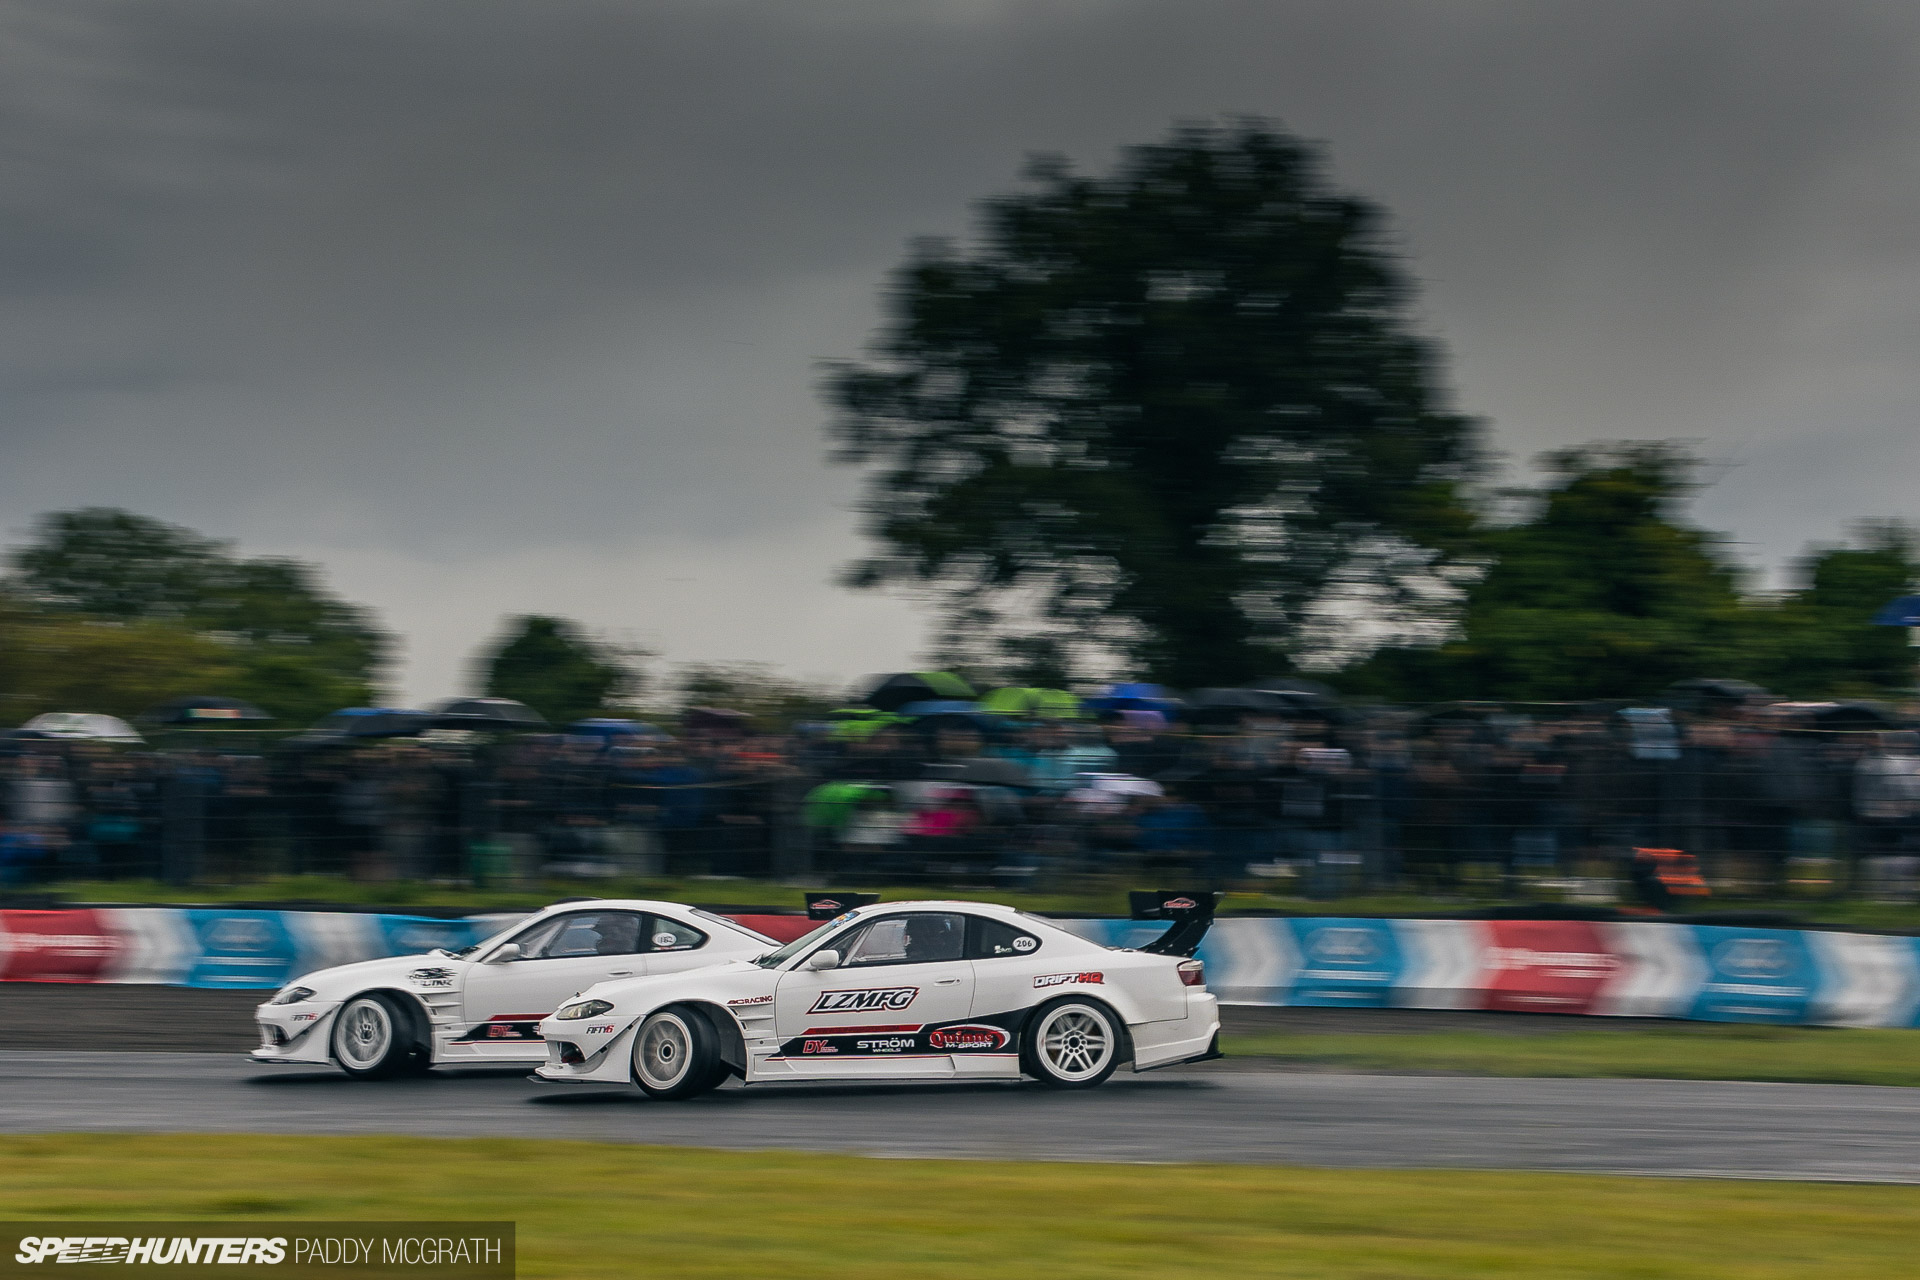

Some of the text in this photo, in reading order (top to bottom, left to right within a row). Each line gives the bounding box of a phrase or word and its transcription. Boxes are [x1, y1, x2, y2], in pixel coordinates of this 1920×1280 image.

[1016, 939, 1033, 948] 206
[745, 995, 773, 1004] RACING
[816, 990, 913, 1010] LZMFG
[487, 1025, 513, 1037] DY
[802, 1039, 828, 1053] DY
[856, 1037, 915, 1049] STRÖM
